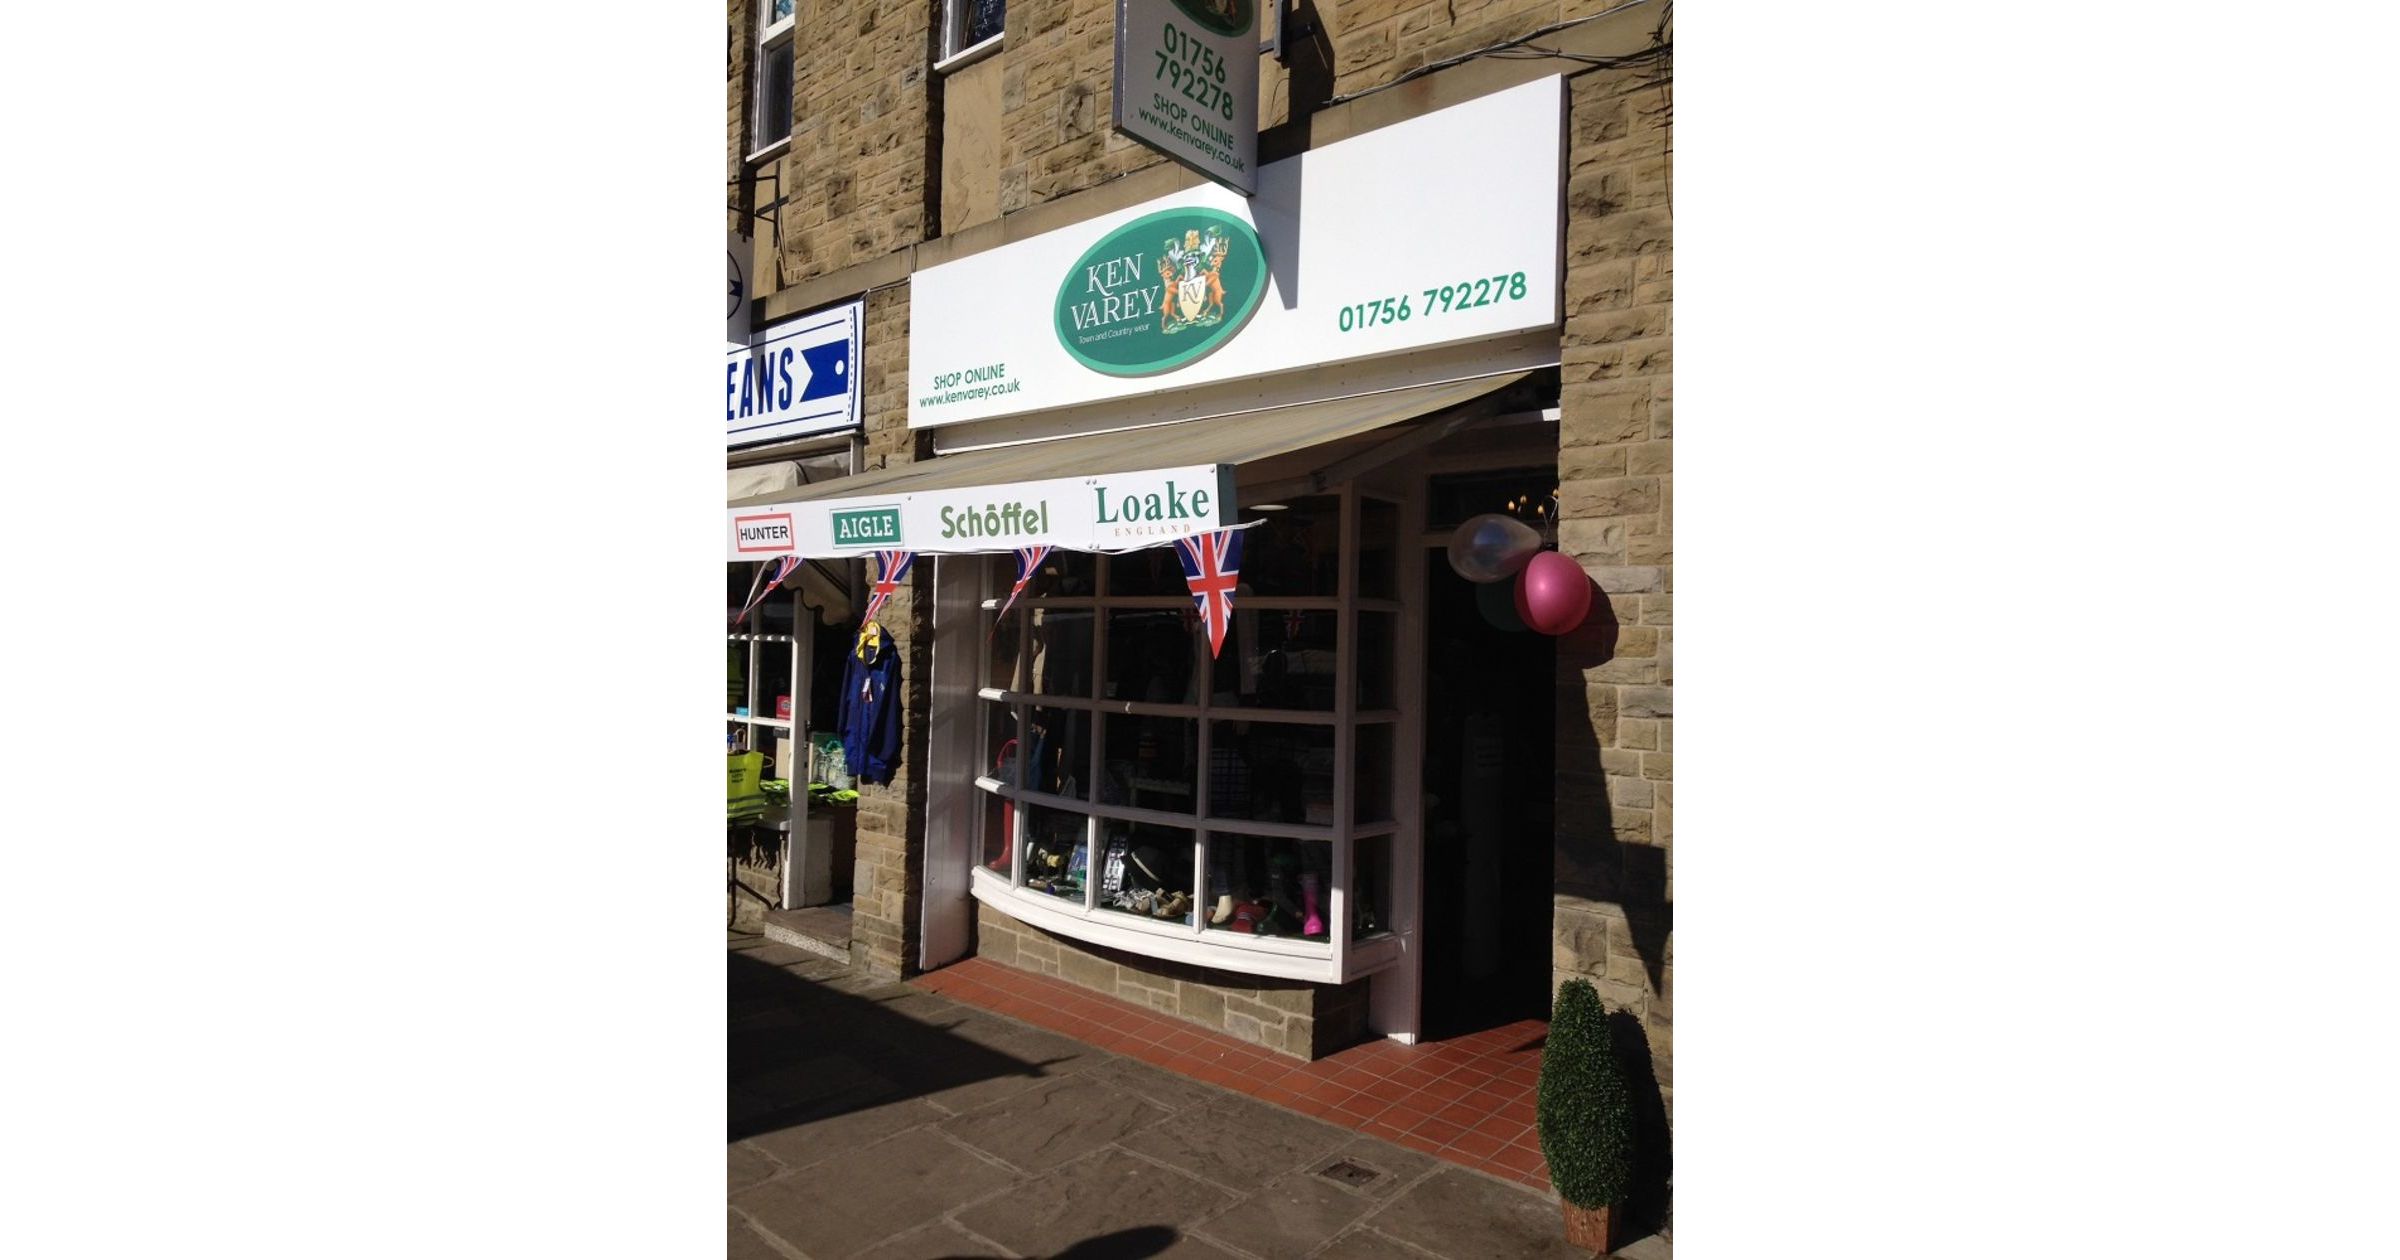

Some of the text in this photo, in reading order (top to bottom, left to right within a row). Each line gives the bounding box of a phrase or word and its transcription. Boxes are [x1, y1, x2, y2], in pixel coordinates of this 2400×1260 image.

[1164, 23, 1226, 84] 01756
[1155, 50, 1233, 121] 792278
[1138, 107, 1245, 173] www.kenvarey.co.uk
[1153, 93, 1234, 150] SHOP ONLINE
[1086, 253, 1143, 296] KEN
[1070, 285, 1160, 331] VAREY
[1339, 271, 1528, 332] 01756 792278
[1079, 335, 1095, 345] Town
[1095, 331, 1107, 342] and
[1107, 327, 1133, 338] Country
[727, 347, 793, 421] EANS
[919, 378, 1020, 408] www.kenvarey.co.uk
[934, 363, 1005, 390] SHOP ONLINE
[1094, 480, 1210, 524] Loake
[740, 525, 789, 541] HUNTER
[839, 515, 894, 539] AIGLE
[1114, 523, 1191, 537] ENGLAND
